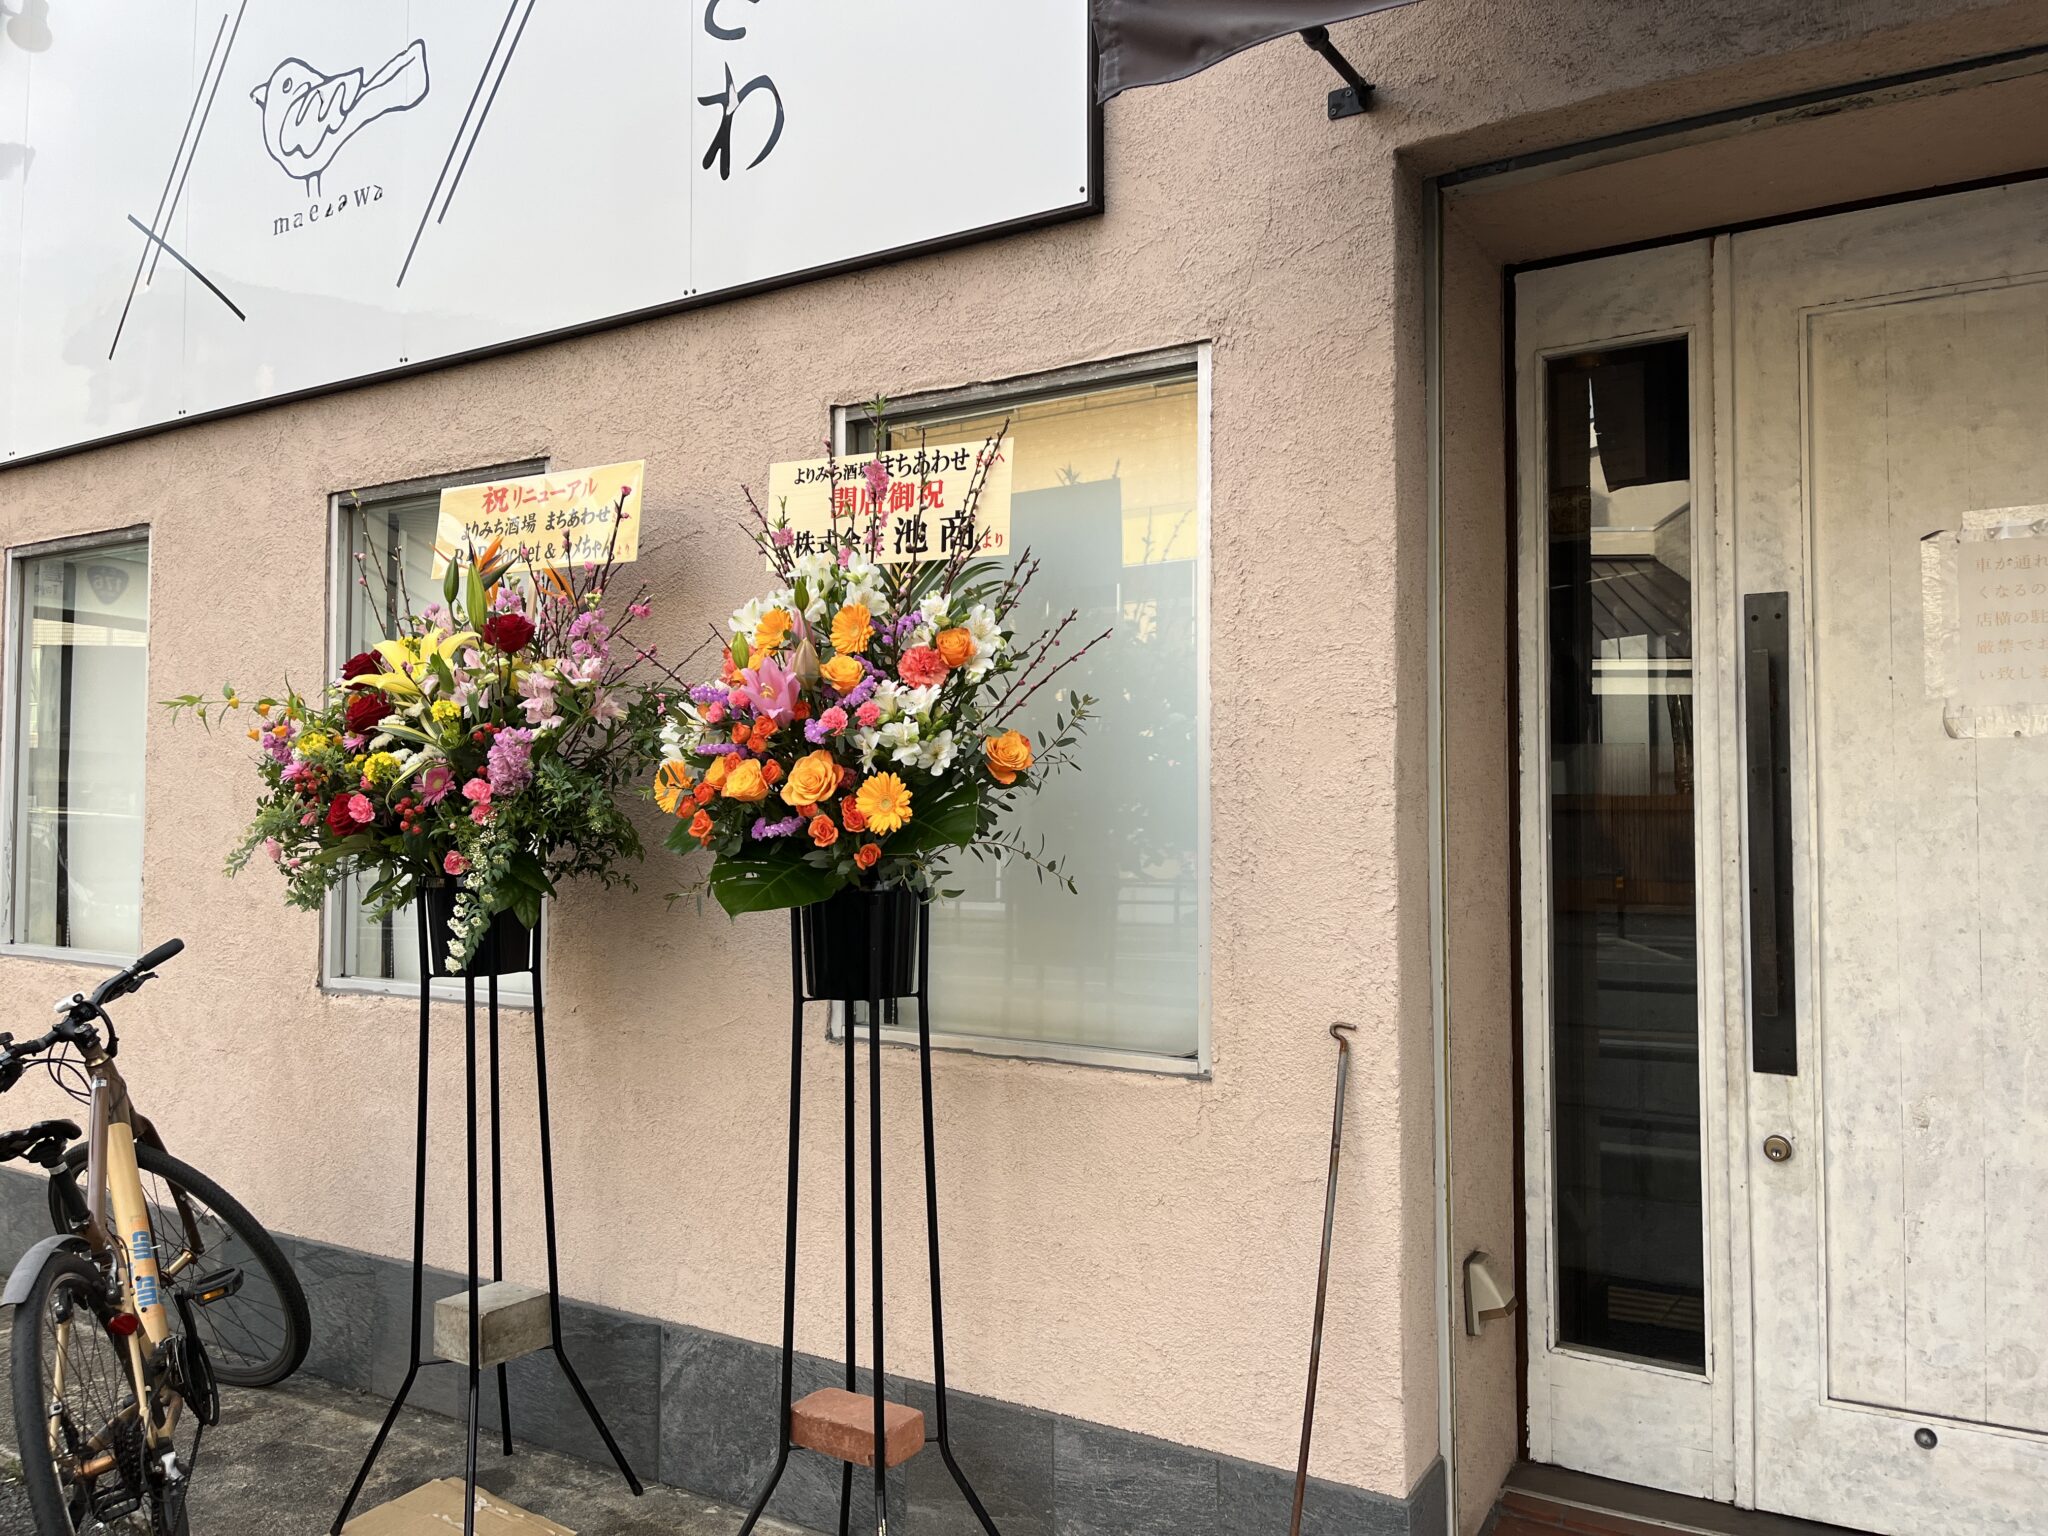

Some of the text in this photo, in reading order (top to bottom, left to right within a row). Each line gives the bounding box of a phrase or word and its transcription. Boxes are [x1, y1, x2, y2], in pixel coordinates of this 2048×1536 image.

[879, 448, 970, 478] まちあわせ
[461, 505, 611, 541] よりみち酒場 まちあわせ
[490, 541, 541, 565] ocket
[544, 543, 557, 559] &
[982, 532, 1003, 548] より
